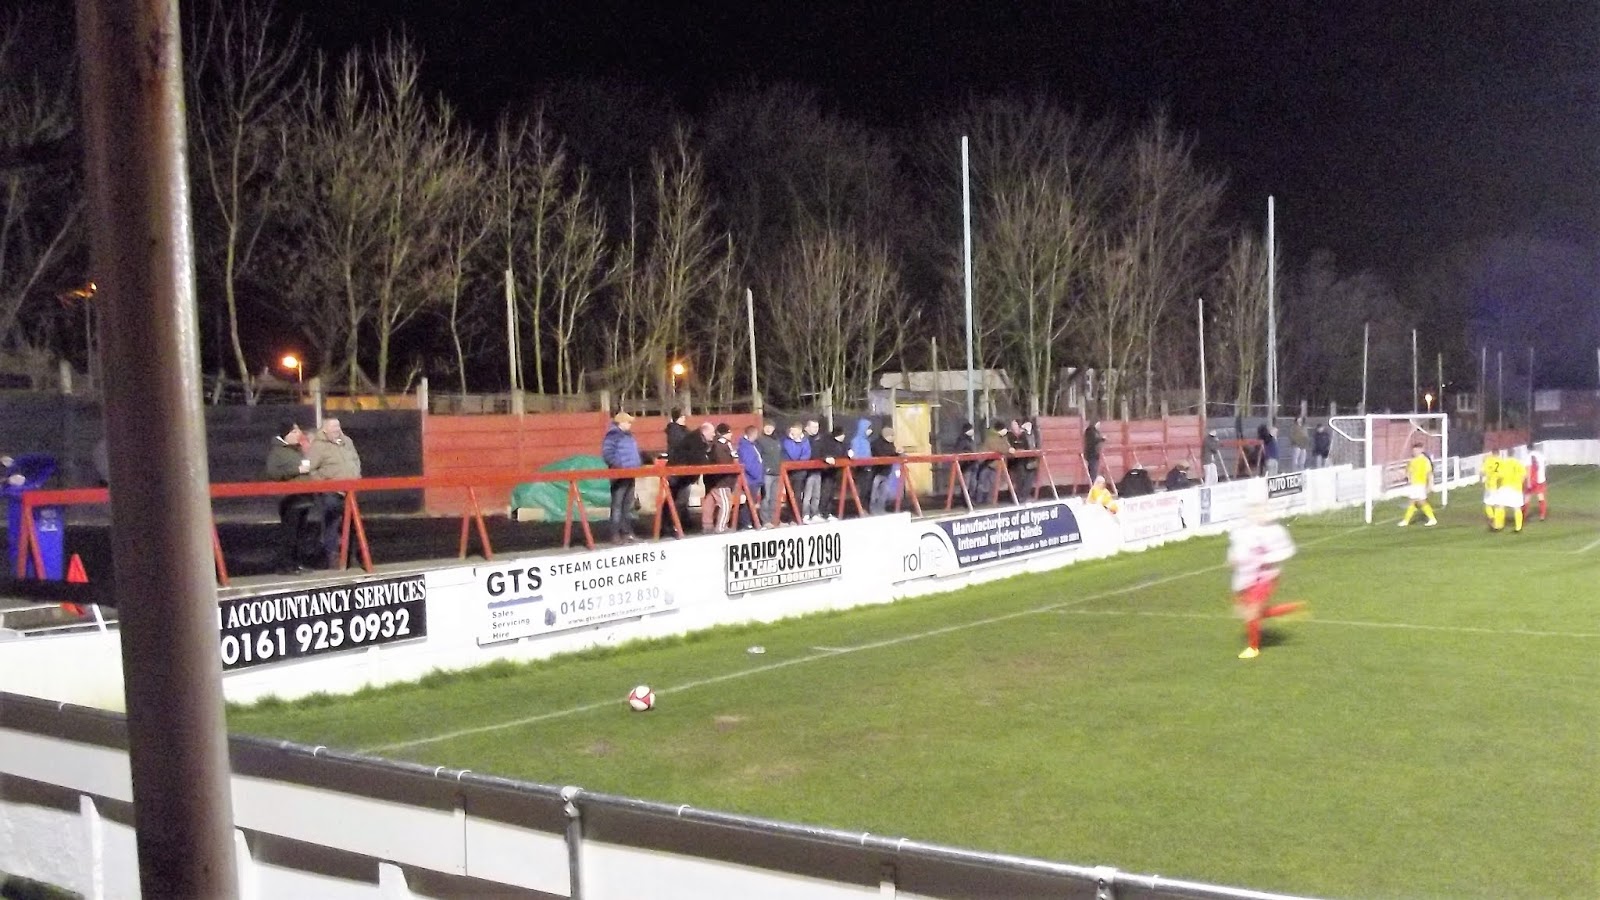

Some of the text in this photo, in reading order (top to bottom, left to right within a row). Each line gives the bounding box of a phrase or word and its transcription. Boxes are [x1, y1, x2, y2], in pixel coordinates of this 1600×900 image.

[1494, 462, 1500, 472] 2
[1269, 475, 1302, 491] AUTO TECH
[952, 507, 1059, 536] Manufacturers of all types of
[990, 527, 1019, 545] window
[1020, 525, 1042, 539] blinds
[550, 550, 666, 577] STEAM CLEANERS &
[729, 540, 777, 571] RADIO
[778, 532, 841, 571] 330 2090
[486, 566, 542, 597] GTS
[574, 570, 648, 592] FLOOR CARE
[730, 565, 841, 591] ADVANCED BOOKING ONLY
[227, 589, 352, 629] ACCOUNTANCY
[355, 579, 426, 610] SERVICES
[560, 586, 660, 616] 01457 832 830
[492, 610, 514, 619] Sales
[492, 618, 530, 630] Servicing
[221, 608, 410, 665] 0161 925 0932
[492, 631, 510, 639] Hire
